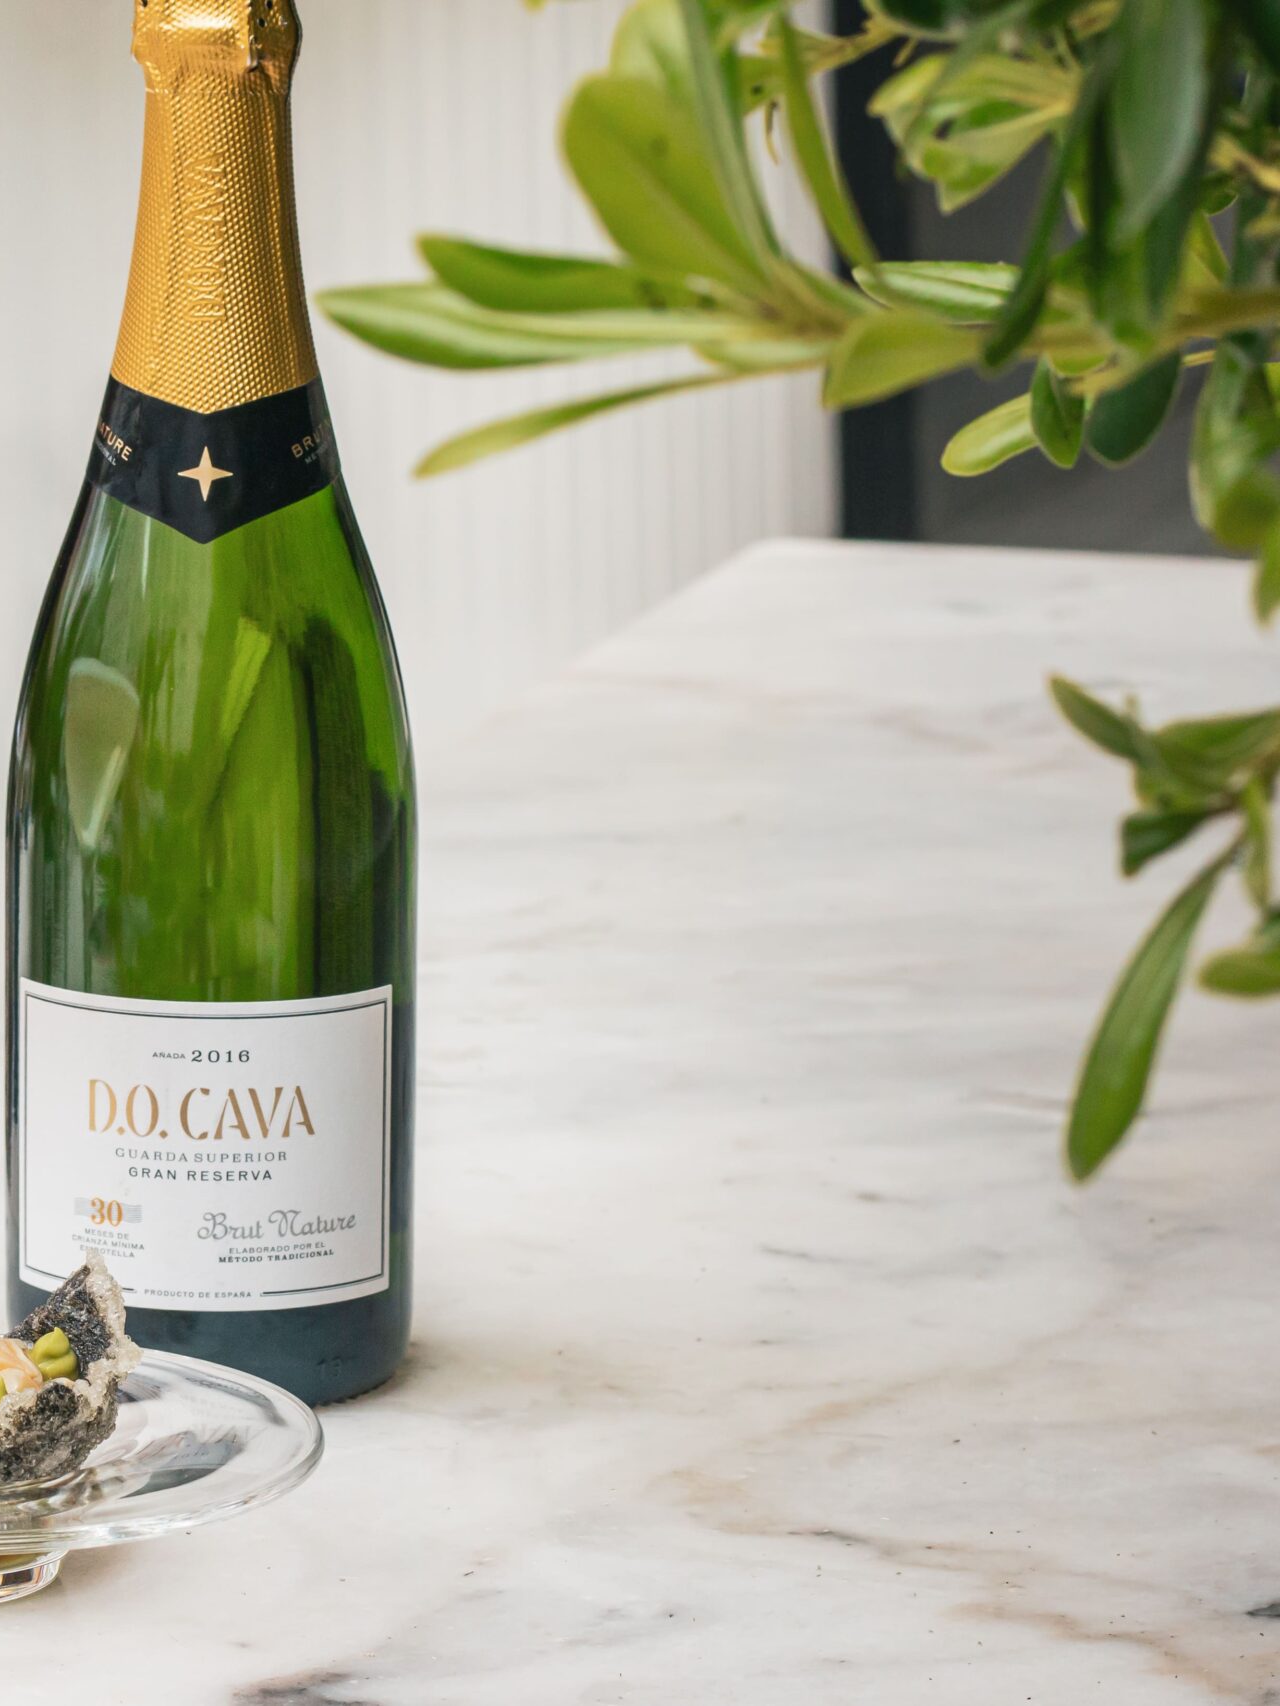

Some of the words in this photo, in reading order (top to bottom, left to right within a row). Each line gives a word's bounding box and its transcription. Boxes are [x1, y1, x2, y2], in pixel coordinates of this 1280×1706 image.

[97, 421, 133, 461] ATURE
[152, 1051, 186, 1060] AÑADA
[191, 1049, 250, 1063] 2016
[88, 1079, 169, 1140] D.O.
[179, 1085, 316, 1140] CAVA
[115, 1147, 188, 1163] GUARDA
[193, 1151, 288, 1163] SUPERIOR
[128, 1166, 177, 1181] GRAN
[187, 1169, 273, 1182] RESERVA
[90, 1196, 123, 1227] 30
[197, 1211, 264, 1240] Brut
[267, 1209, 357, 1238] Nature
[72, 1234, 108, 1246] CRIANZA
[111, 1240, 145, 1250] MÍNIMA
[84, 1228, 114, 1239] MESES
[117, 1232, 130, 1240] DE
[228, 1244, 290, 1254] ELABORADO
[293, 1242, 312, 1251] POR
[315, 1241, 326, 1249] EL
[218, 1253, 263, 1263] MÉTODO
[267, 1249, 334, 1262] TRADICIONAL
[144, 1288, 195, 1298] PRODUCTO
[214, 1290, 251, 1299] ESPAÑA
